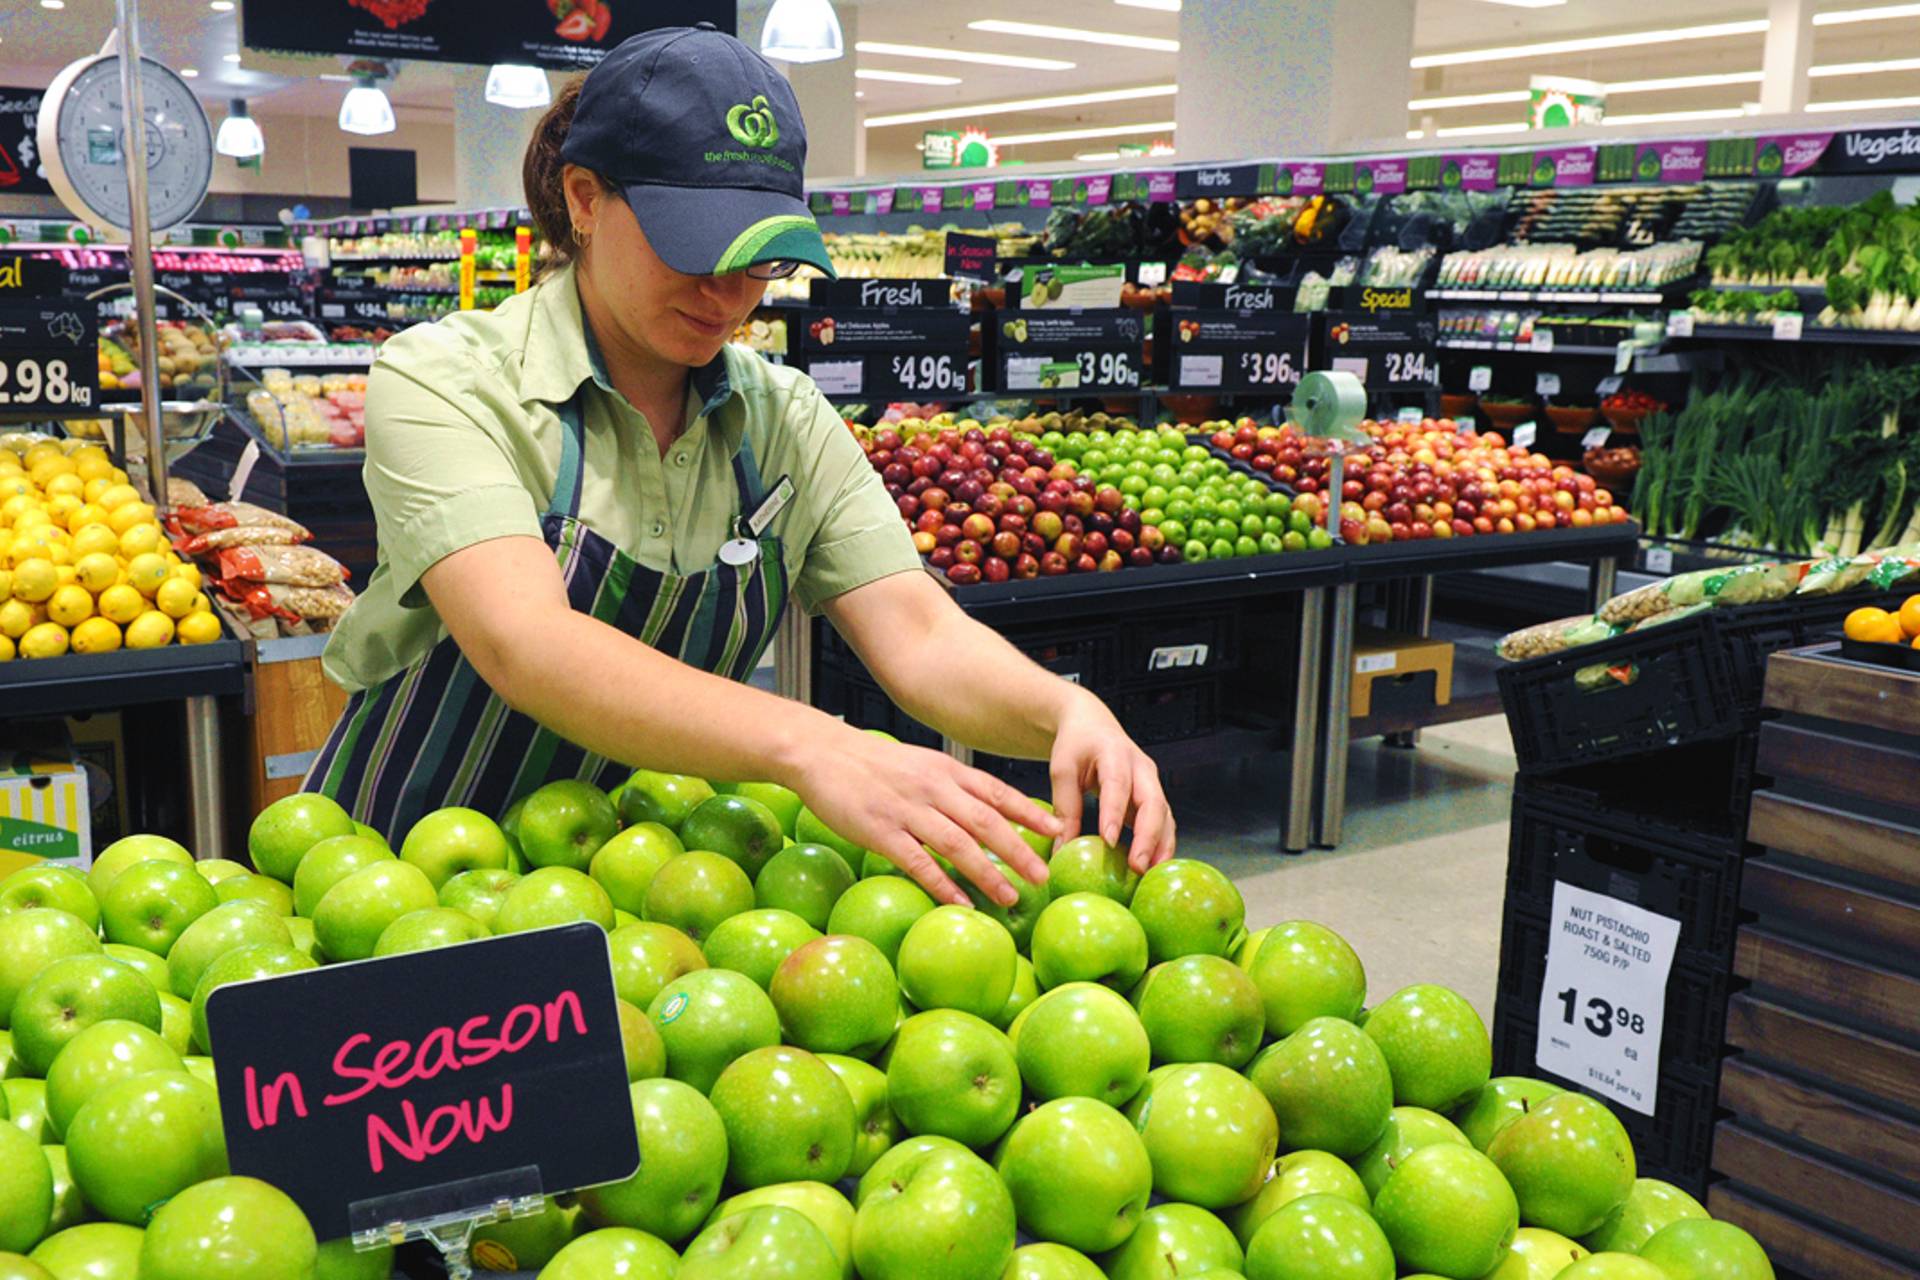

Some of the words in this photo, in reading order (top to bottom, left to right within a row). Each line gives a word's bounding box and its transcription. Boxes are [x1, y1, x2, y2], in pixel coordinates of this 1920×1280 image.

[1462, 164, 1495, 179] Easter
[1557, 159, 1593, 174] Easter
[1662, 152, 1703, 169] Easter
[1197, 169, 1232, 186] Herbs
[861, 279, 923, 306] Fresh
[1224, 285, 1274, 309] Fresh
[1360, 288, 1411, 313] Special
[12, 831, 65, 848] citrus
[1570, 905, 1593, 922] NUT
[1596, 913, 1650, 945] PISTACHIO
[1563, 920, 1600, 942] ROAST
[1602, 933, 1611, 947] &
[1613, 938, 1652, 964] SALTED
[1583, 943, 1611, 964] 750G
[244, 1066, 308, 1130] In
[323, 990, 588, 1106] Season
[1624, 1046, 1639, 1061] ea
[366, 1083, 513, 1173] Now
